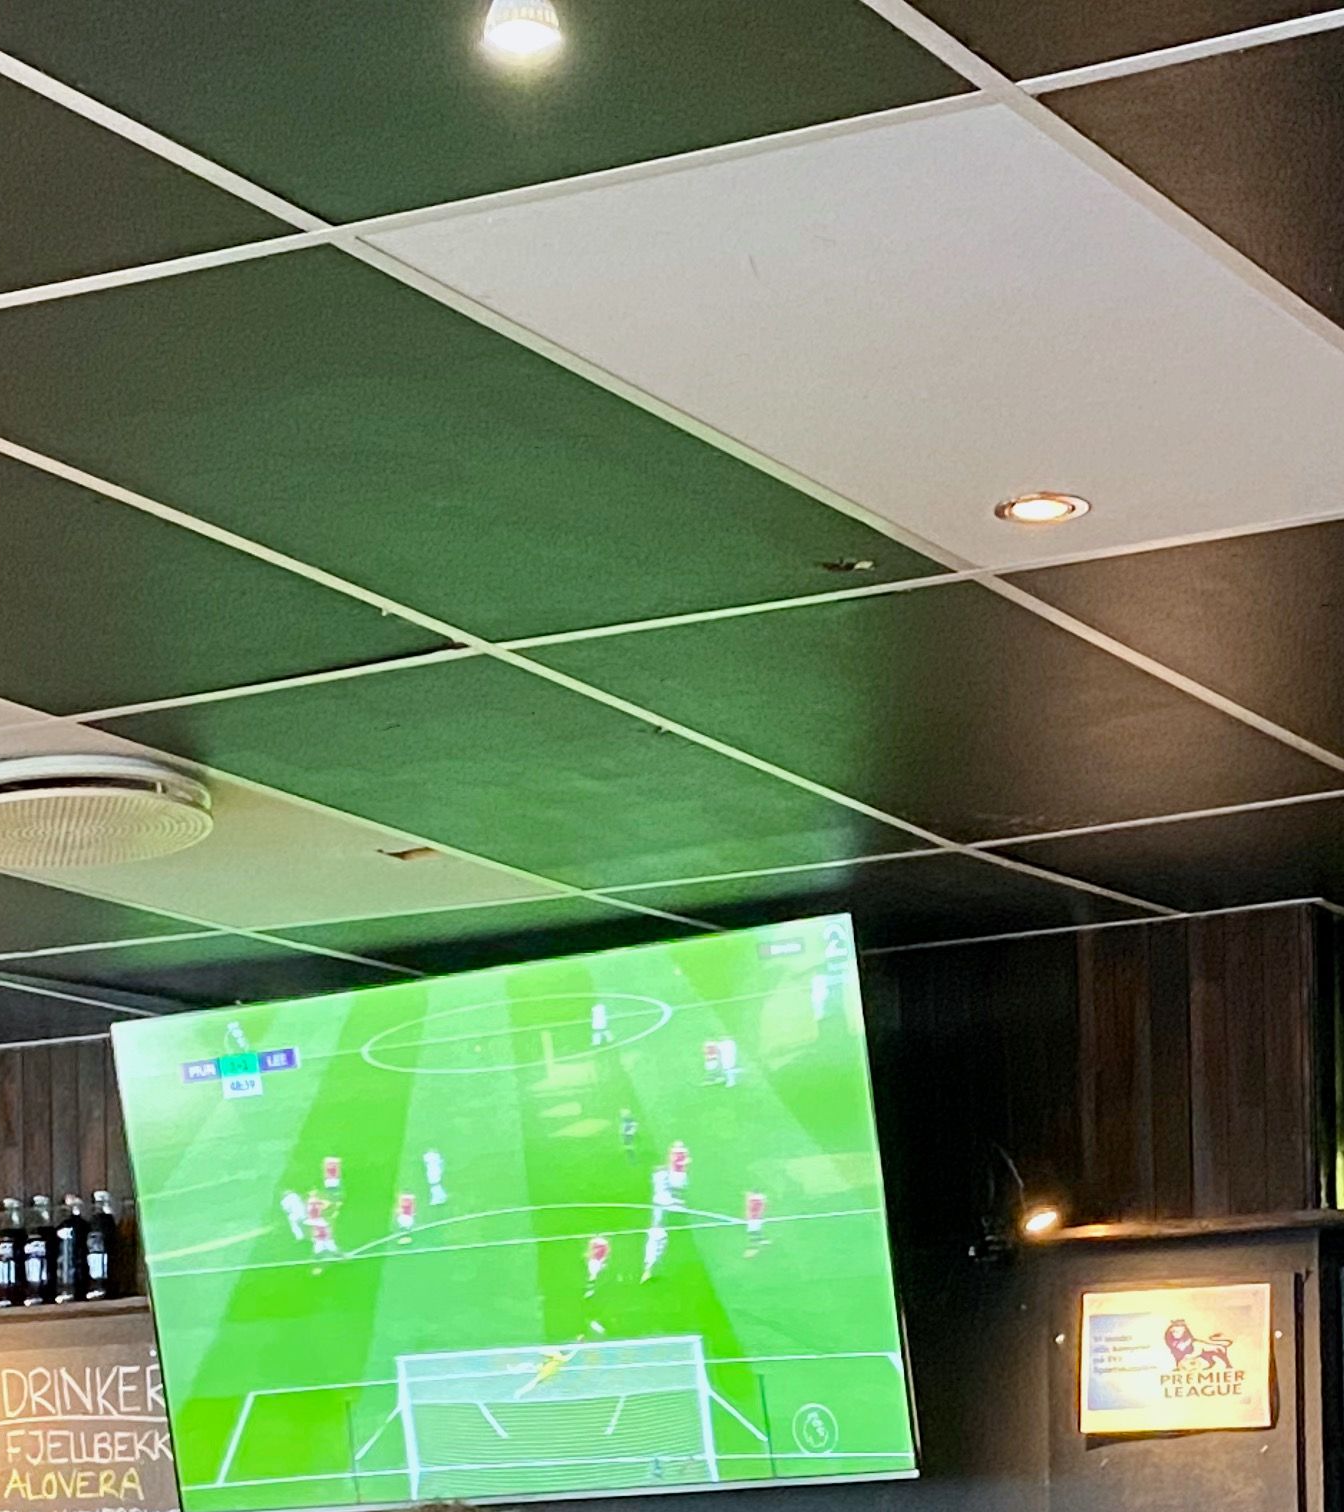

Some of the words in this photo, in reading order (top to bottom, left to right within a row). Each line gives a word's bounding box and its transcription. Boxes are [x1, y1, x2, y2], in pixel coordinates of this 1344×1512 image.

[1159, 1370, 1246, 1387] PREMIER
[1164, 1383, 1243, 1399] LEAGUE
[5, 1428, 175, 1466] FJELLBEKK
[3, 1466, 146, 1502] ALOVERA
